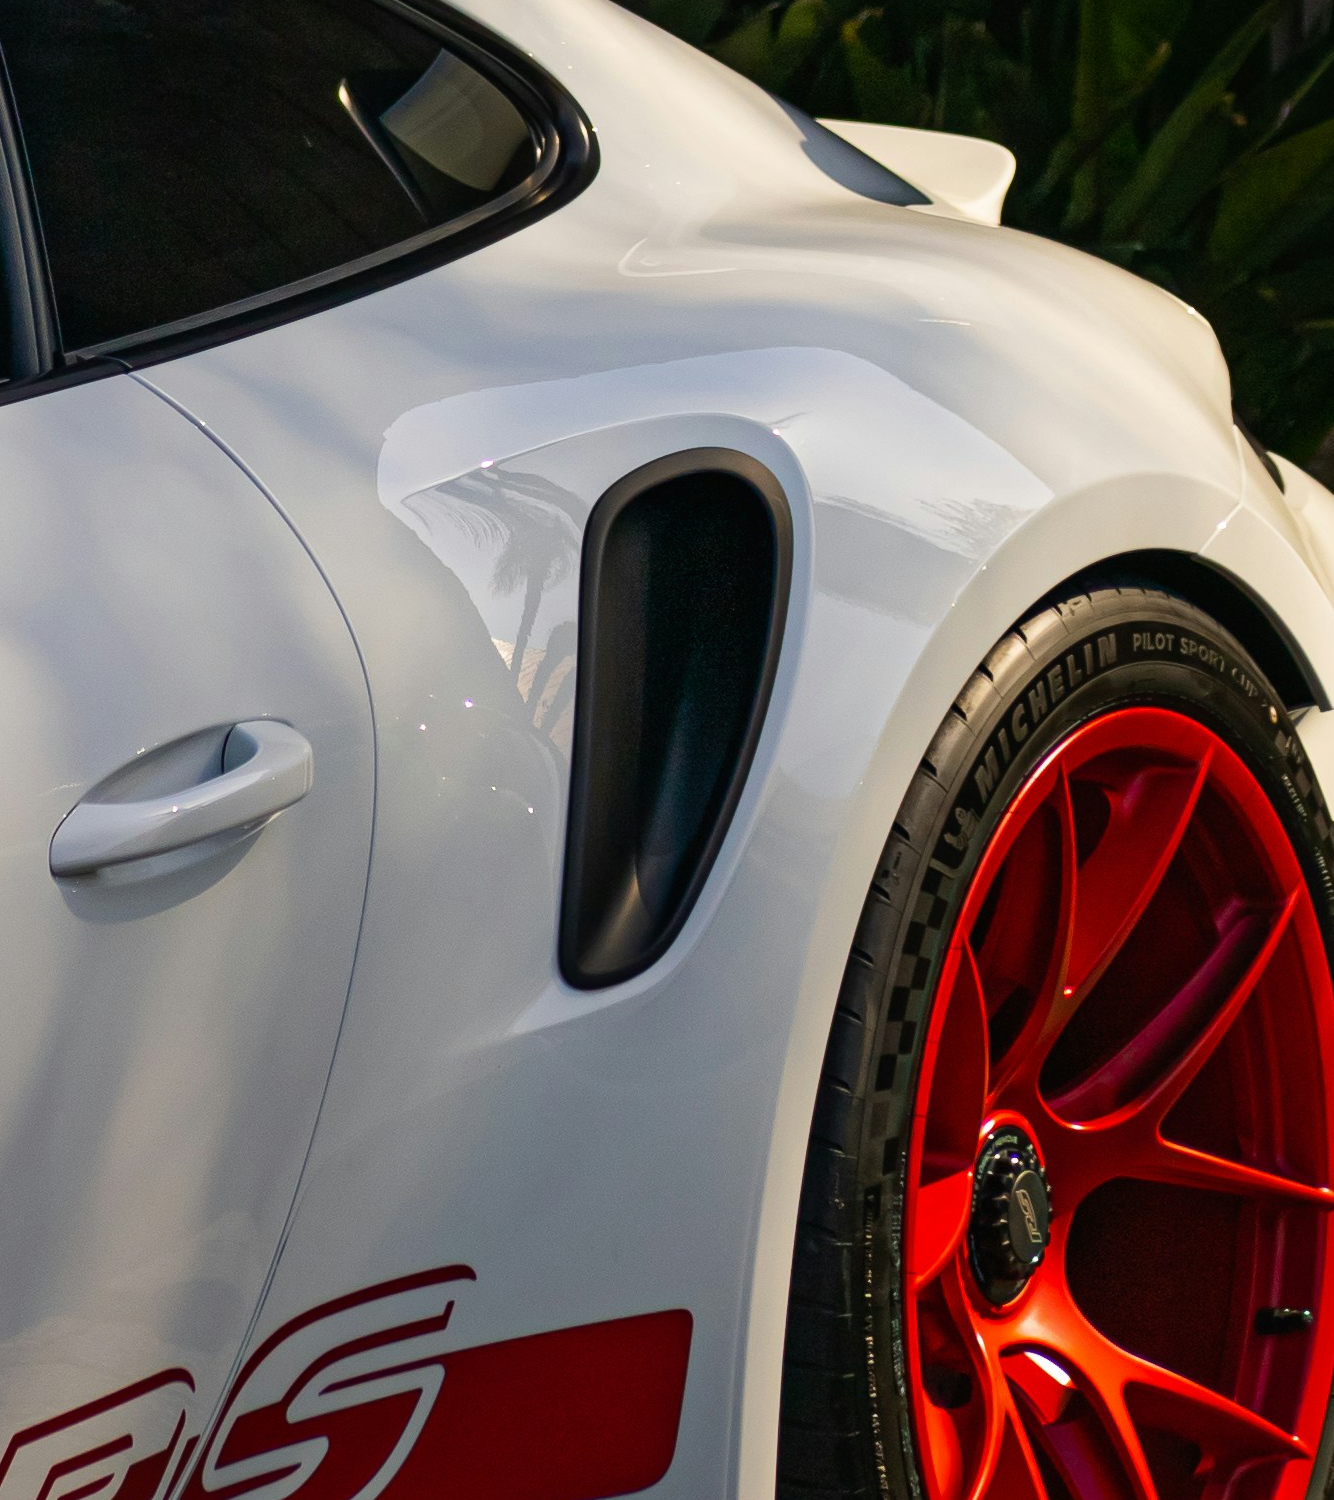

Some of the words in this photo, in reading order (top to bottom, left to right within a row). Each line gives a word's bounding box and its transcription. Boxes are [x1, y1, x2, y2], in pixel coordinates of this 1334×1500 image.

[973, 632, 1117, 795] MICHELIN
[1133, 632, 1175, 652] PILOT
[1180, 637, 1226, 673] SPORT
